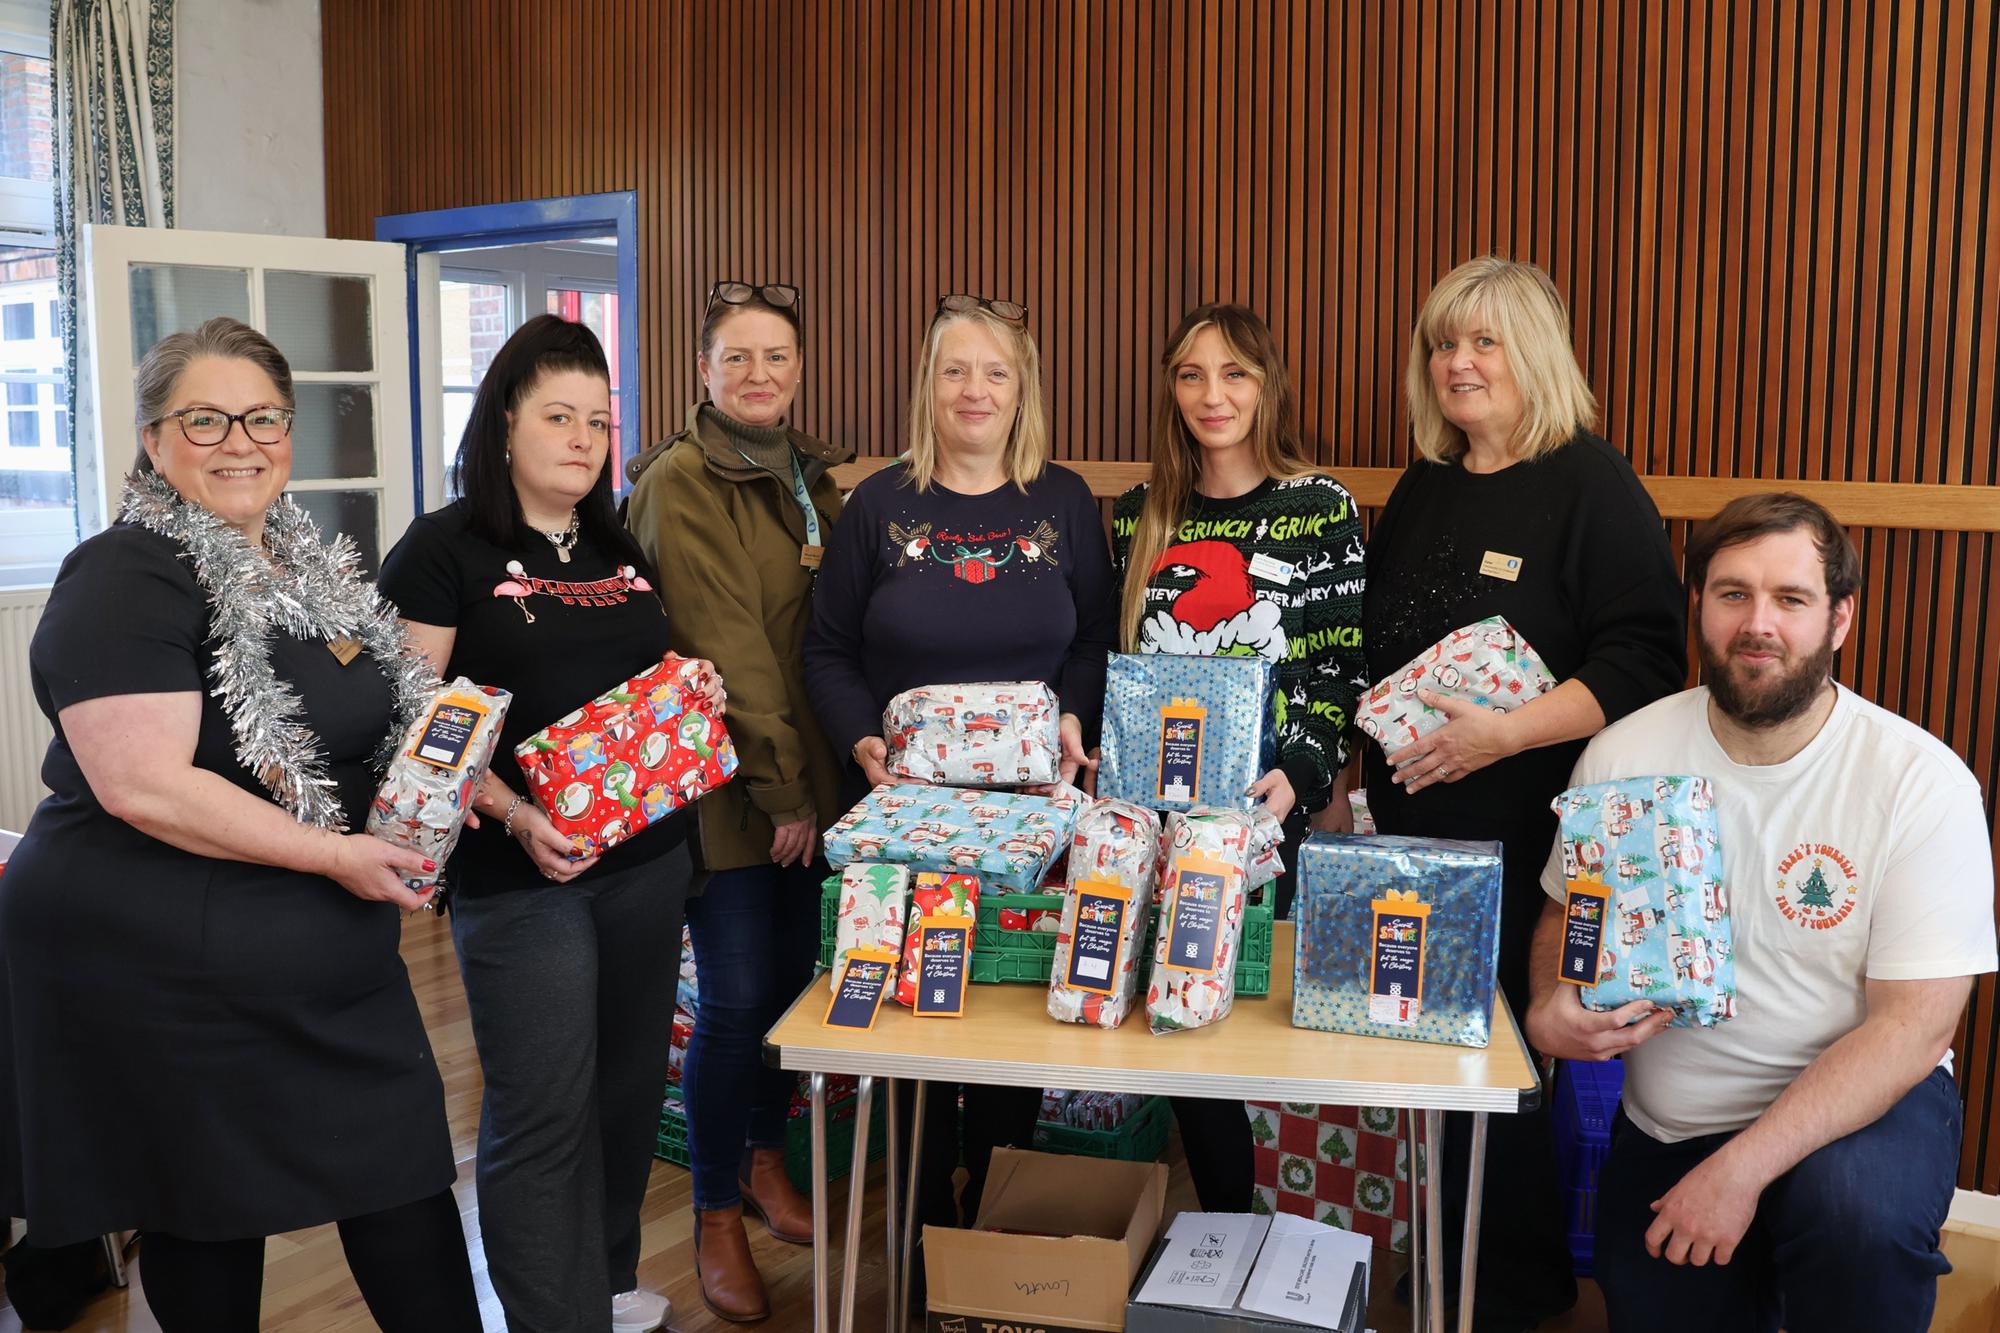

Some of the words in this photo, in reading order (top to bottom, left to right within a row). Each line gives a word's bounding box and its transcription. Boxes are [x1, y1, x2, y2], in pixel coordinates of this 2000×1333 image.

[1179, 519, 1253, 541] GRINCH
[531, 575, 628, 595] FLAMINGO
[1198, 902, 1218, 910] everyone
[1098, 925, 1117, 933] everyone
[1388, 962, 1412, 971] Christmas
